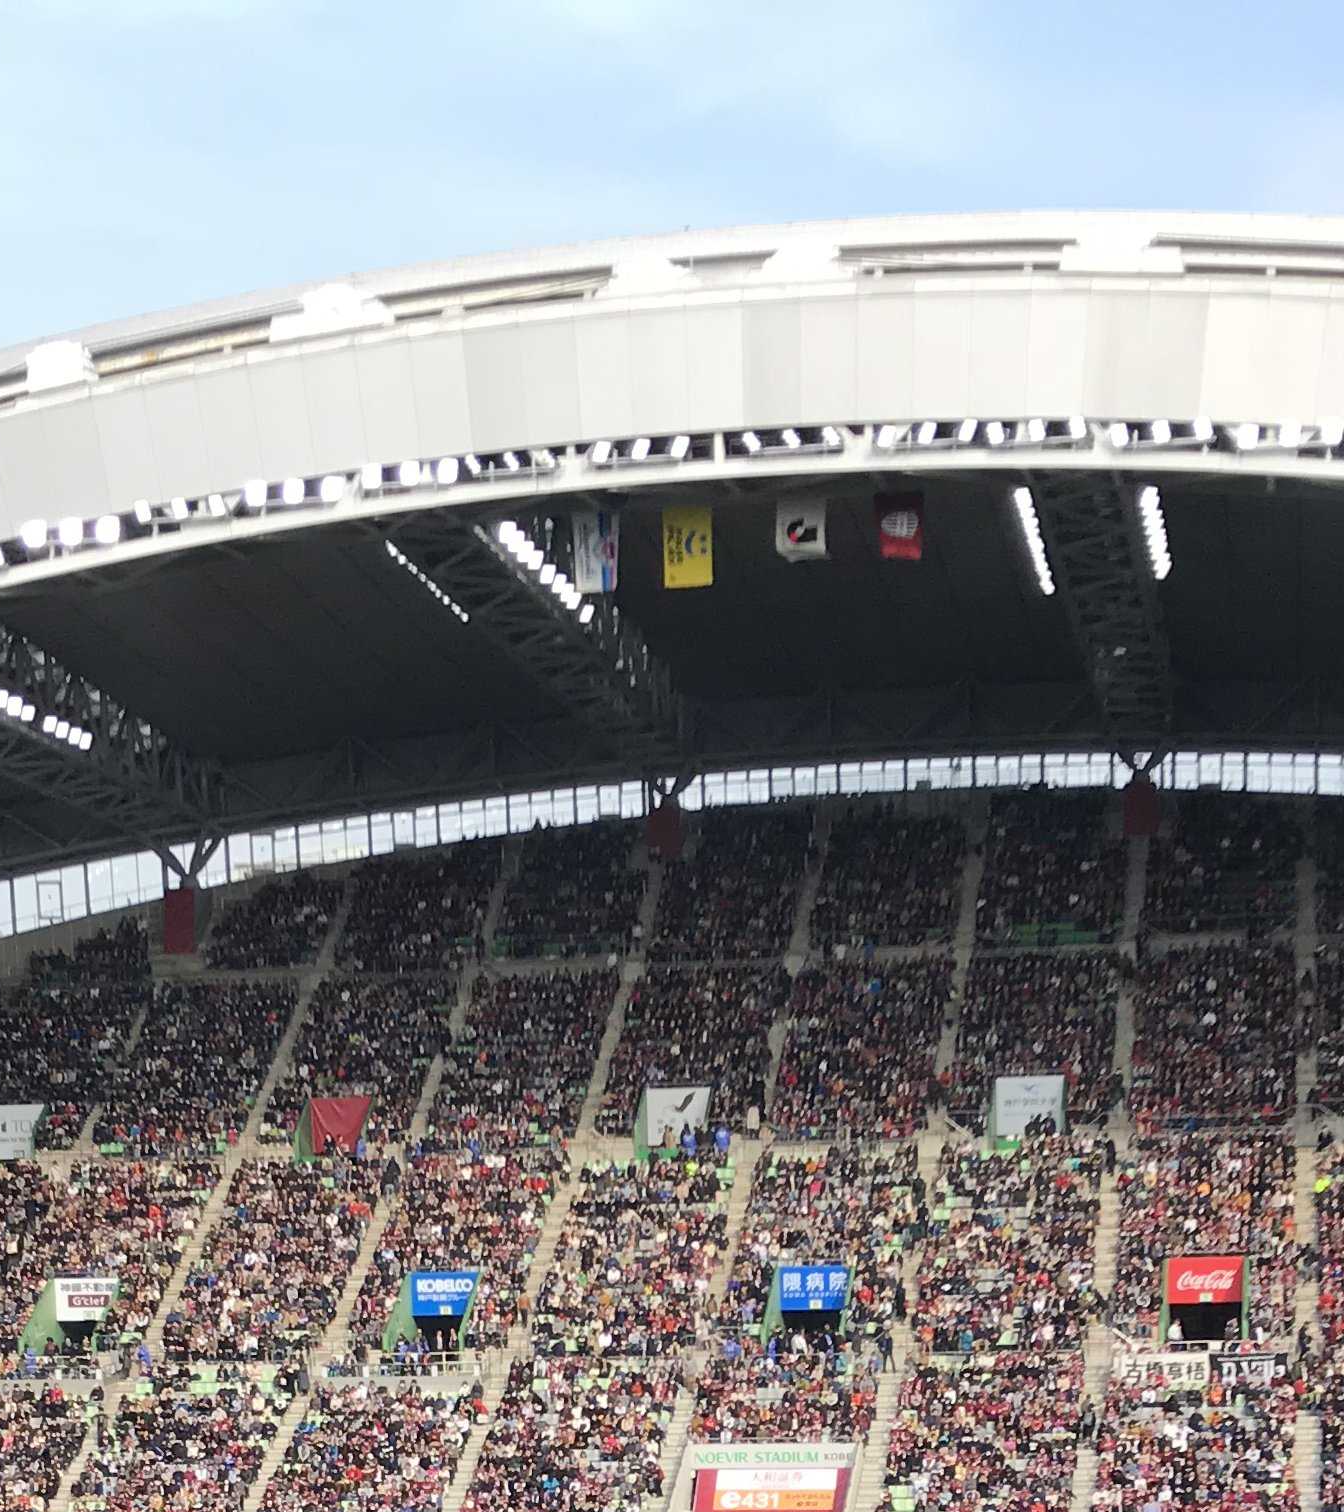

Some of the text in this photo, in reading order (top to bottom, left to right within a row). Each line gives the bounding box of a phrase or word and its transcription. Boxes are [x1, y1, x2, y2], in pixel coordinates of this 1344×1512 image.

[416, 1278, 473, 1293] KOBELCO
[694, 1452, 748, 1464] NOEVIR
[756, 1451, 819, 1463] STADIUM
